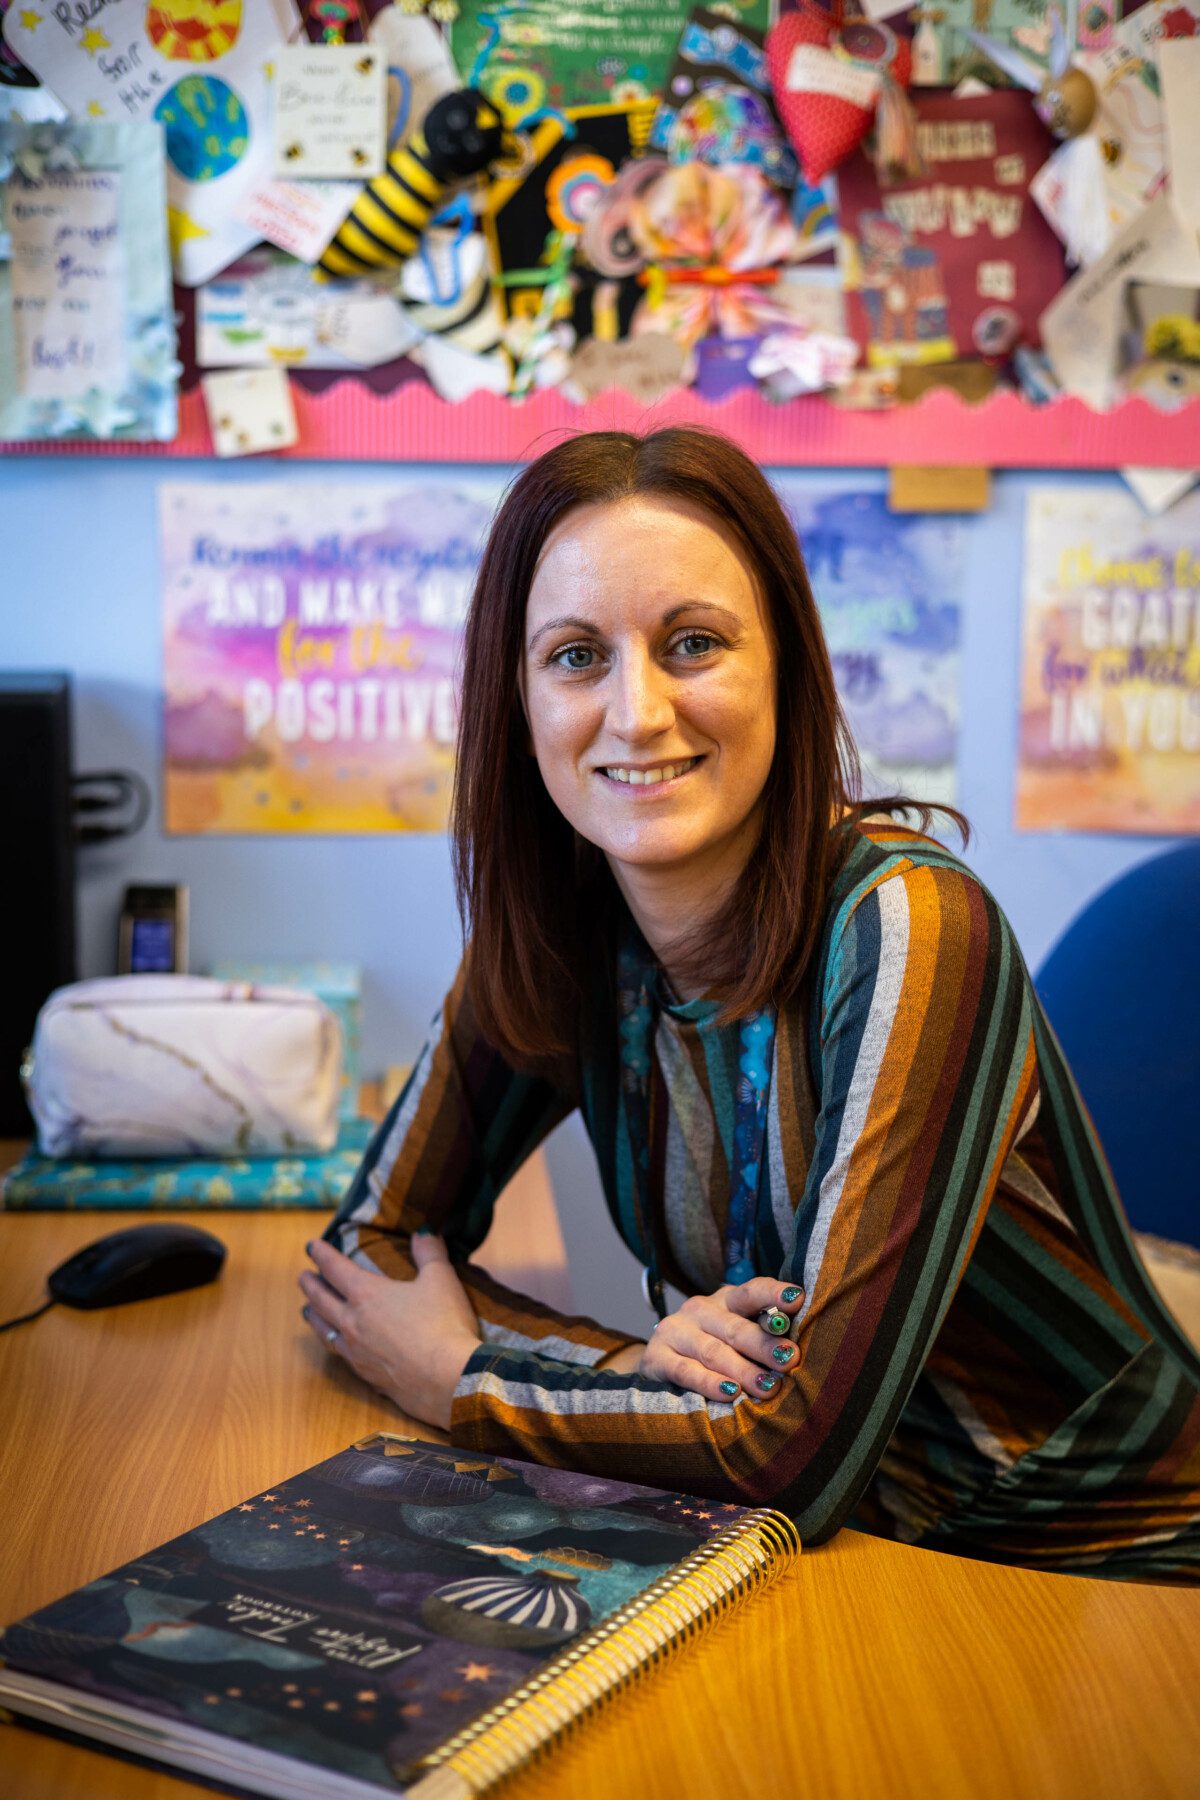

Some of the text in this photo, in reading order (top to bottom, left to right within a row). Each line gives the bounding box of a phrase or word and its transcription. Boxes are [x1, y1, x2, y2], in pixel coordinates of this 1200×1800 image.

[207, 576, 287, 628] AND
[299, 576, 401, 630] MAKE
[1082, 587, 1200, 651] GRAT
[277, 618, 424, 680] for the
[1050, 692, 1100, 751] IN
[233, 1593, 312, 1620] NOTEBOOK
